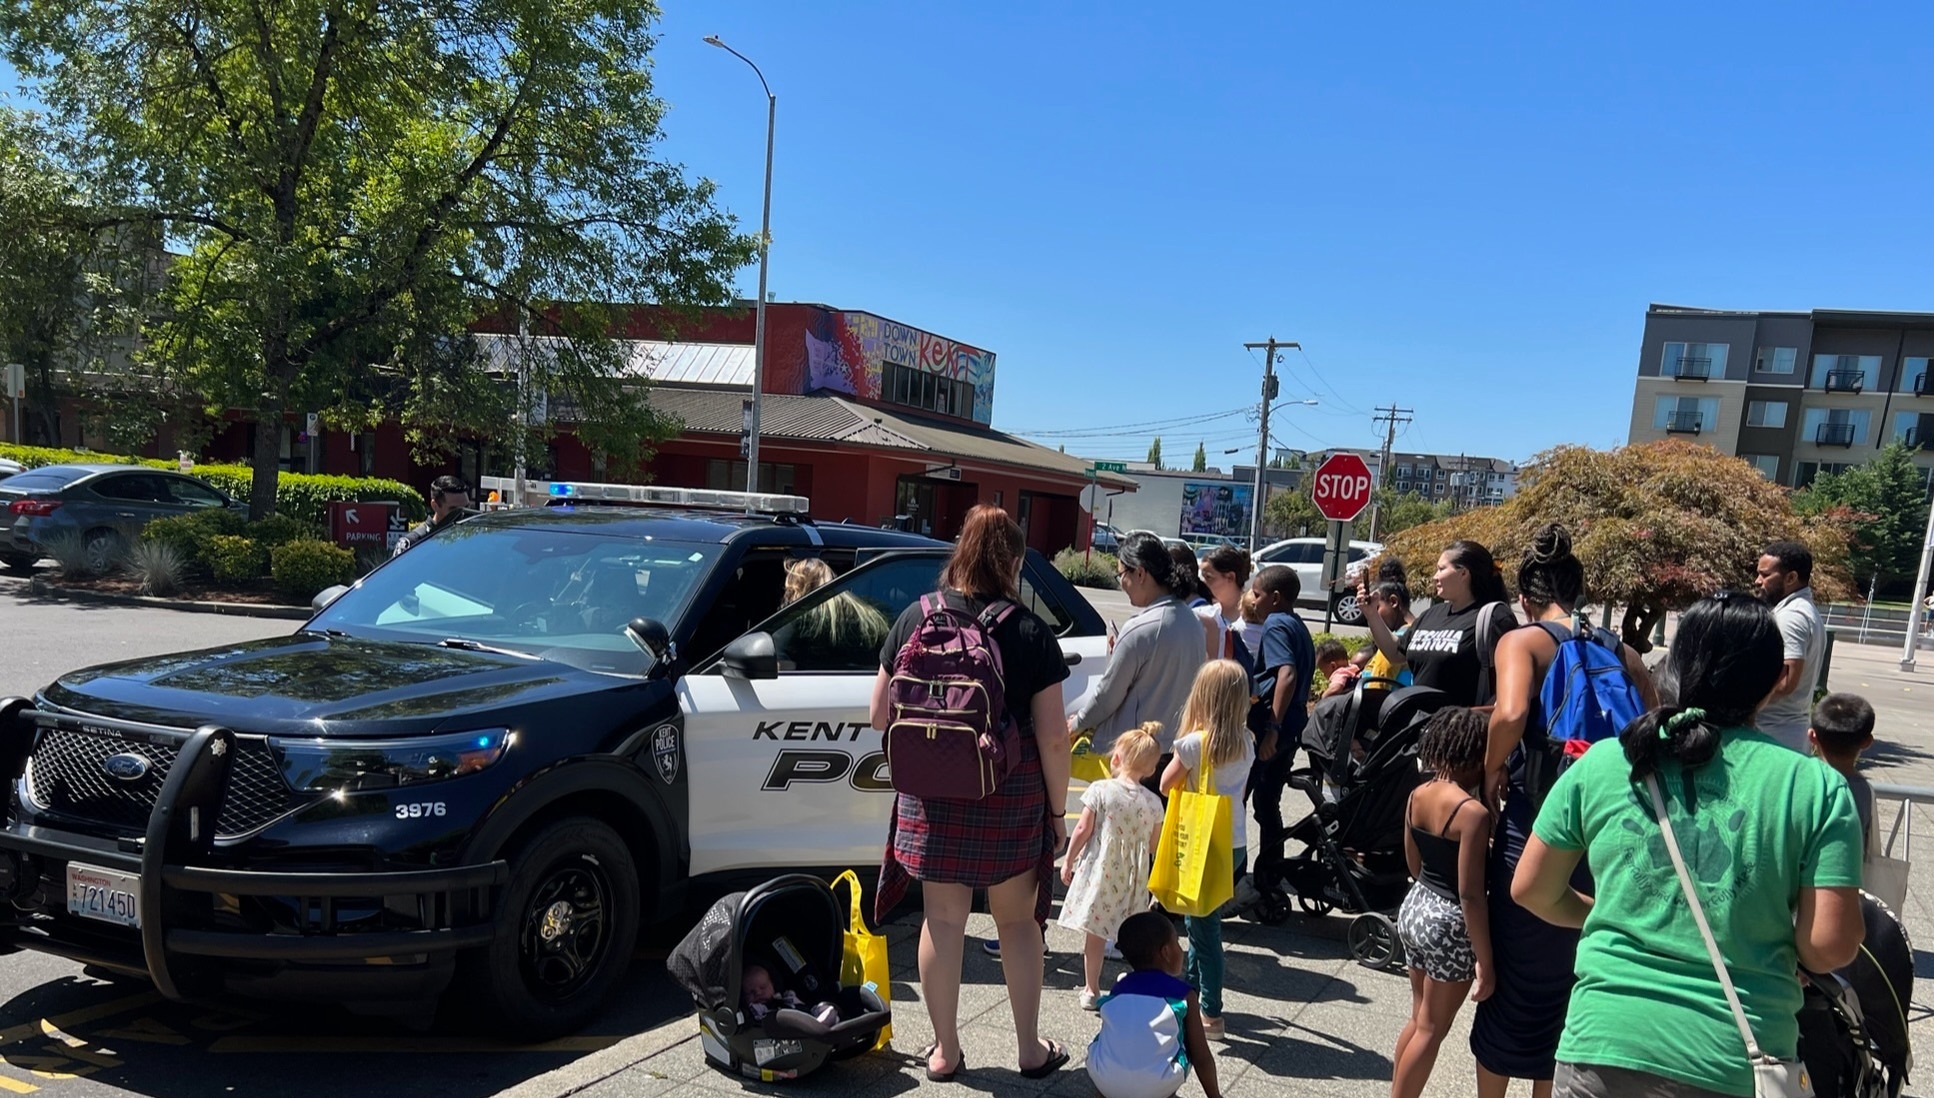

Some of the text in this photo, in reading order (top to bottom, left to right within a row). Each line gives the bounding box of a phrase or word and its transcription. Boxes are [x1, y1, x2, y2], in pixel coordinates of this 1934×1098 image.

[883, 322, 917, 346] DOWN
[883, 342, 916, 366] TOWN
[1108, 463, 1120, 472] Ave
[1317, 474, 1369, 501] STOP
[346, 532, 381, 542] PARKING
[82, 725, 122, 739] SETINA
[658, 726, 672, 739] KENT
[752, 721, 871, 742] KENT
[655, 735, 676, 751] POLICE
[395, 802, 447, 820] 3976
[71, 872, 112, 887] WASHINGTON
[80, 884, 136, 919] 72145D
